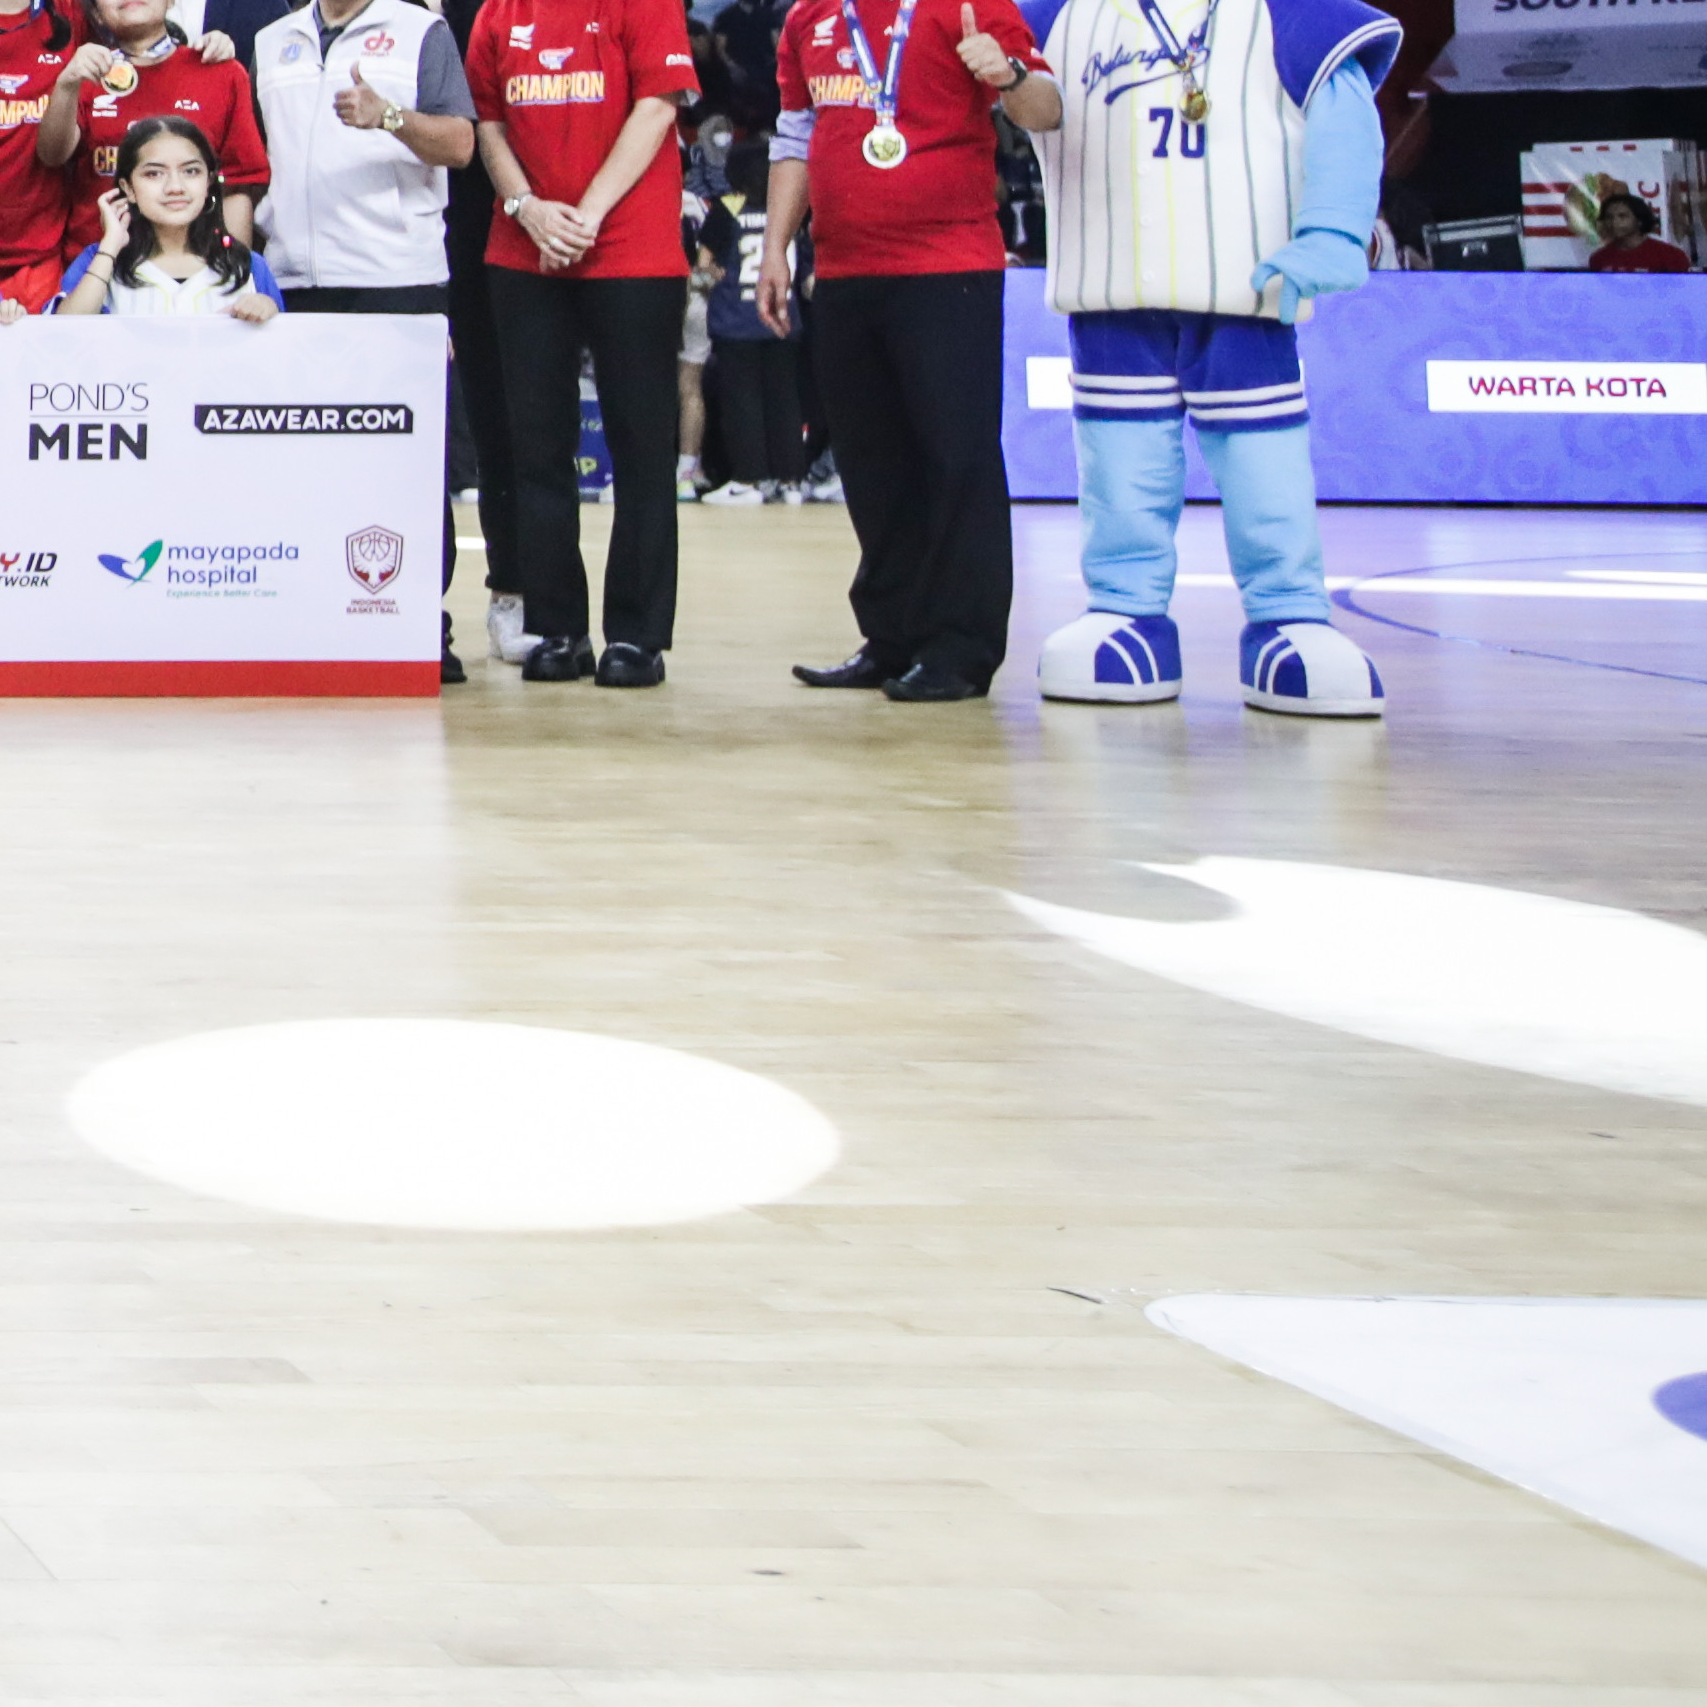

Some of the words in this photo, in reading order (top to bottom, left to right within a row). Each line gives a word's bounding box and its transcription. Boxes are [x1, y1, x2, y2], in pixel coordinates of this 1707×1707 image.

[505, 71, 604, 106] CHAMPION
[1150, 107, 1205, 159] 70
[29, 382, 149, 411] POND'S
[1469, 376, 1575, 396] WARTA
[1586, 377, 1667, 396] KOTA
[203, 409, 407, 431] AZAWEAR.COM
[29, 423, 148, 461] MEN
[168, 542, 299, 564] mayapada
[167, 565, 257, 587] hospital
[167, 589, 220, 598] Experience
[254, 589, 278, 597] Care
